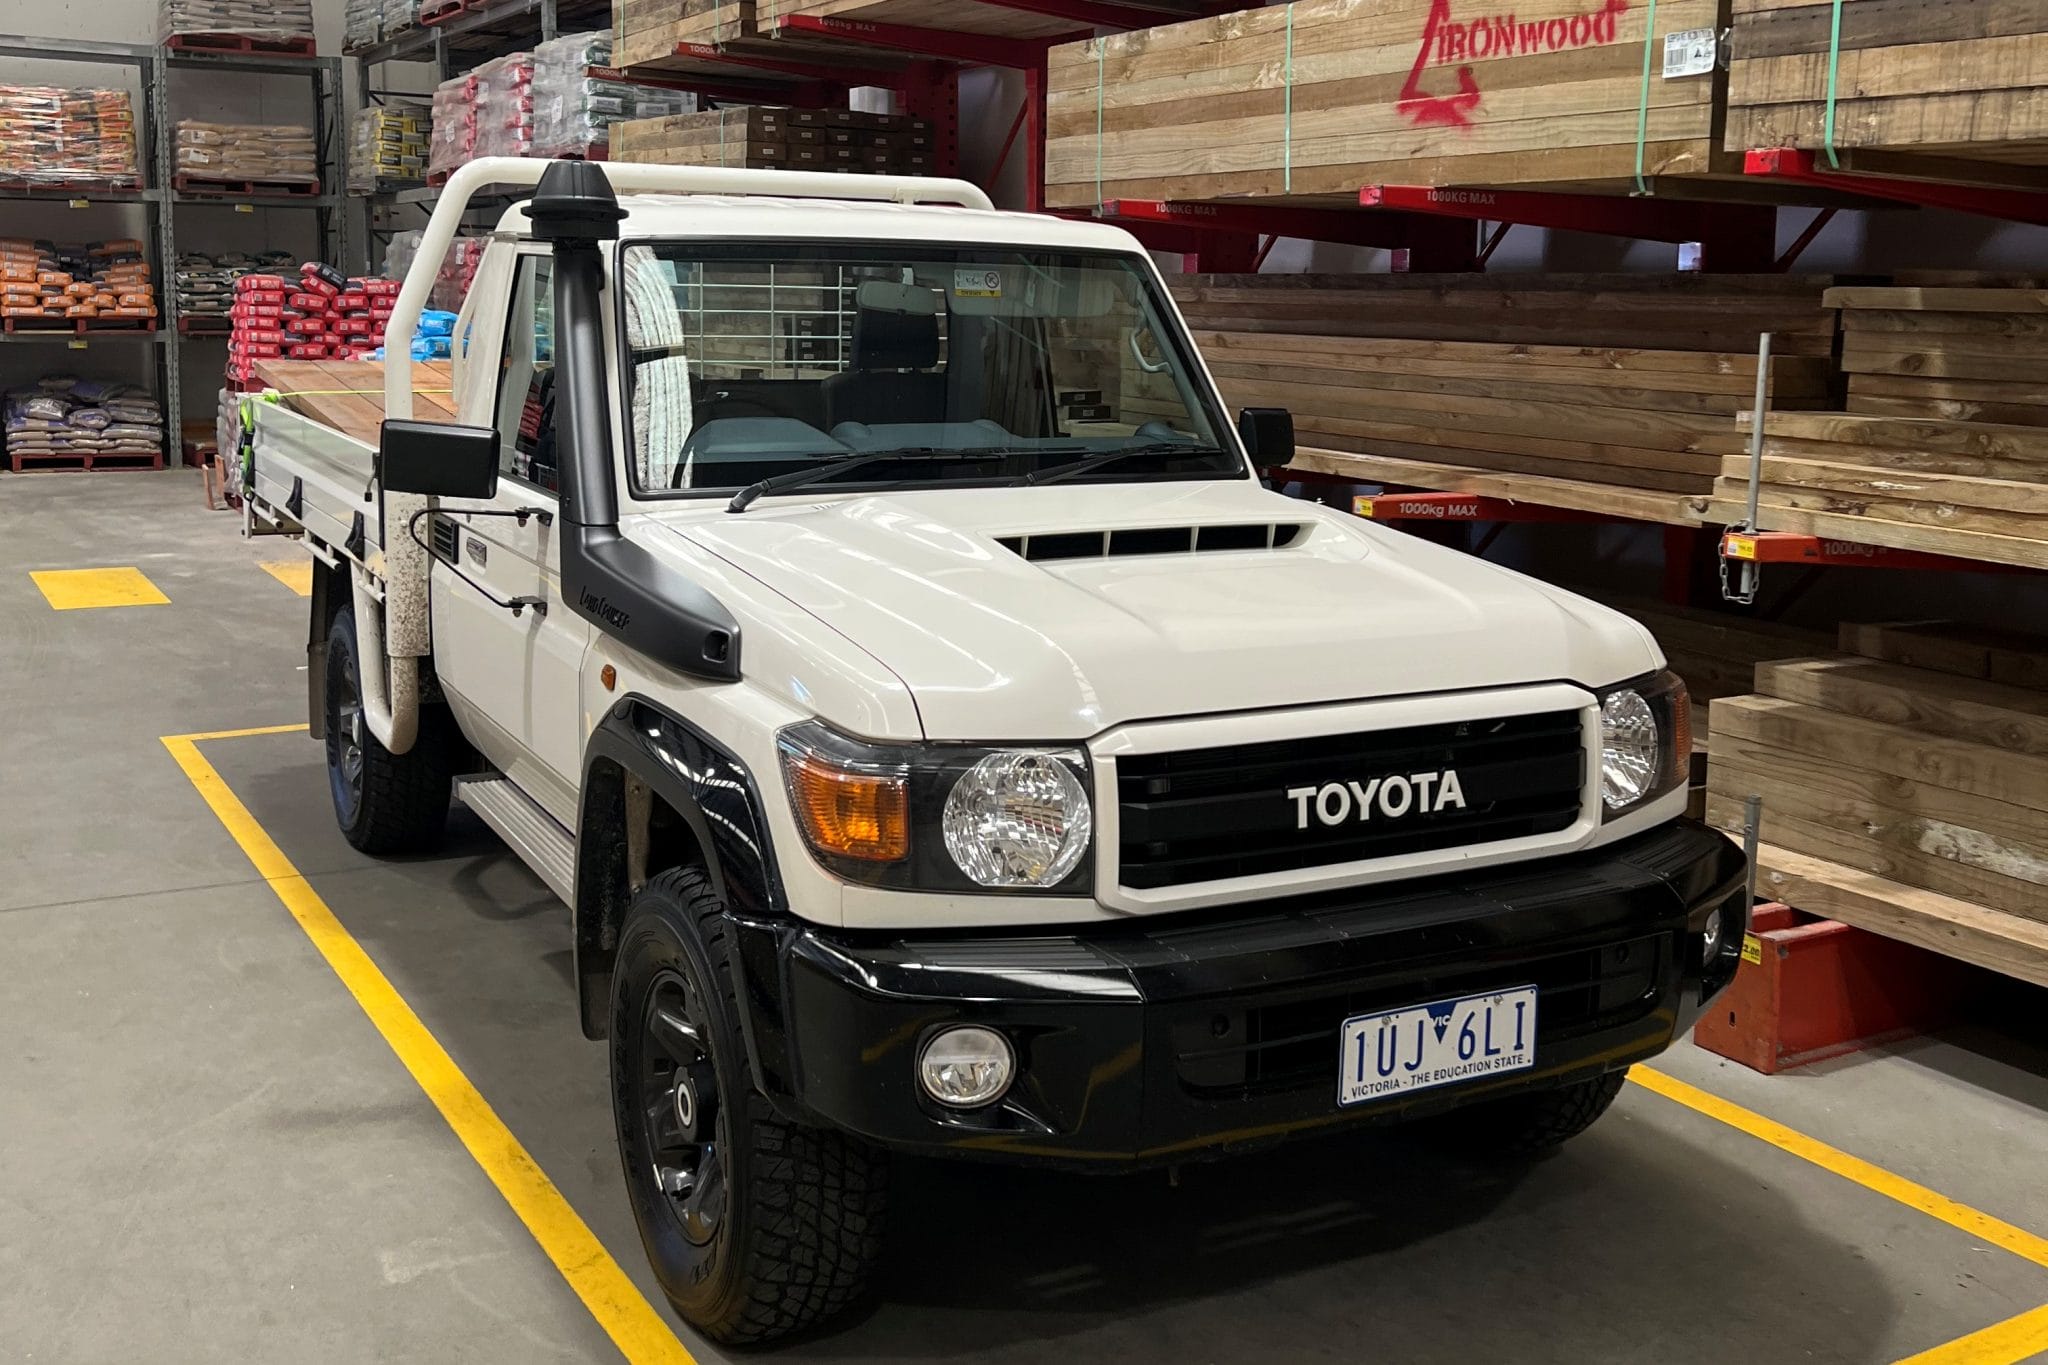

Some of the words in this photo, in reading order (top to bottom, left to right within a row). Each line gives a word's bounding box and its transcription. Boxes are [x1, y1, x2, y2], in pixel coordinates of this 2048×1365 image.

[1426, 190, 1468, 203] 1000KG
[1469, 192, 1496, 205] MAX
[1155, 203, 1193, 214] 1000KG
[1194, 205, 1218, 216] MAX
[1399, 502, 1444, 518] 1000kg
[1448, 504, 1478, 517] MAX
[1287, 769, 1467, 829] TOYOTA
[1432, 1014, 1450, 1027] VIC
[1351, 1077, 1401, 1099] VICTORIA
[1410, 1069, 1430, 1086] THE
[1433, 1060, 1492, 1081] EDUCATION
[1494, 1054, 1524, 1069] STATE
